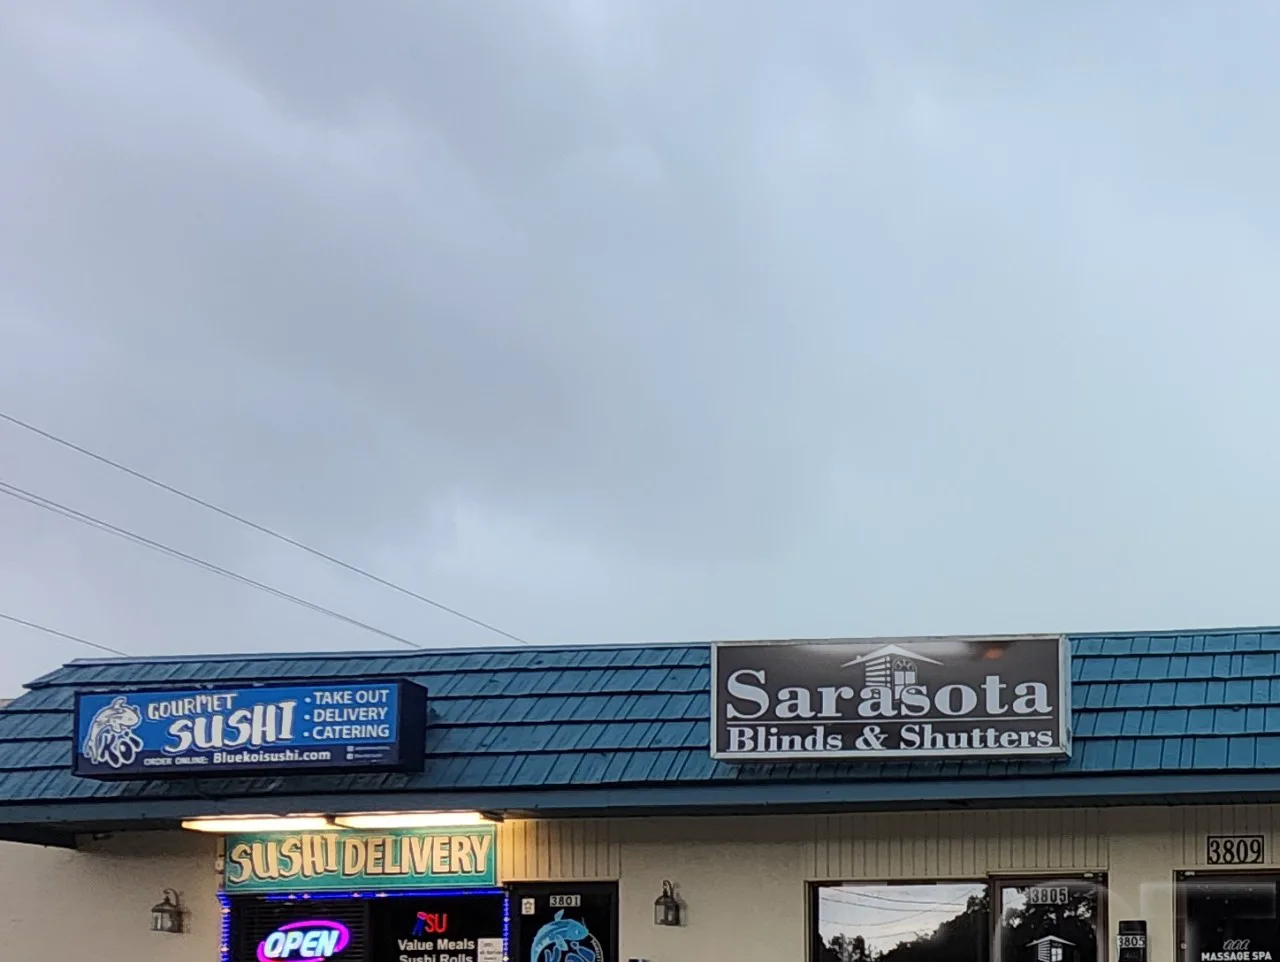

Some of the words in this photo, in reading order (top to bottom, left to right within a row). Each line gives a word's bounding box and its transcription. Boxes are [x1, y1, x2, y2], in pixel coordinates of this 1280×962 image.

[314, 690, 353, 705] TAKE
[356, 689, 389, 704] OUT
[726, 669, 1053, 719] Sarasota
[147, 693, 238, 721] GOURMET
[313, 707, 387, 723] DELIVERY
[165, 701, 297, 753] SUSHI
[312, 724, 390, 740] CATERING
[726, 724, 842, 751] Blinds
[855, 725, 890, 750] &
[900, 724, 1053, 750] Shutters
[213, 749, 331, 764] Bluekoisushi.com
[228, 833, 341, 884] SUSHI
[342, 834, 491, 876] DELIVERY
[1209, 839, 1261, 864] 3809
[551, 896, 578, 906] 3801
[1031, 888, 1066, 902] 3805
[263, 930, 340, 958] OPEN
[398, 939, 434, 950] Value
[437, 938, 475, 950] Meals
[1118, 936, 1145, 947] 3805
[1201, 951, 1250, 961] MASSAGE
[1252, 951, 1272, 960] SPA
